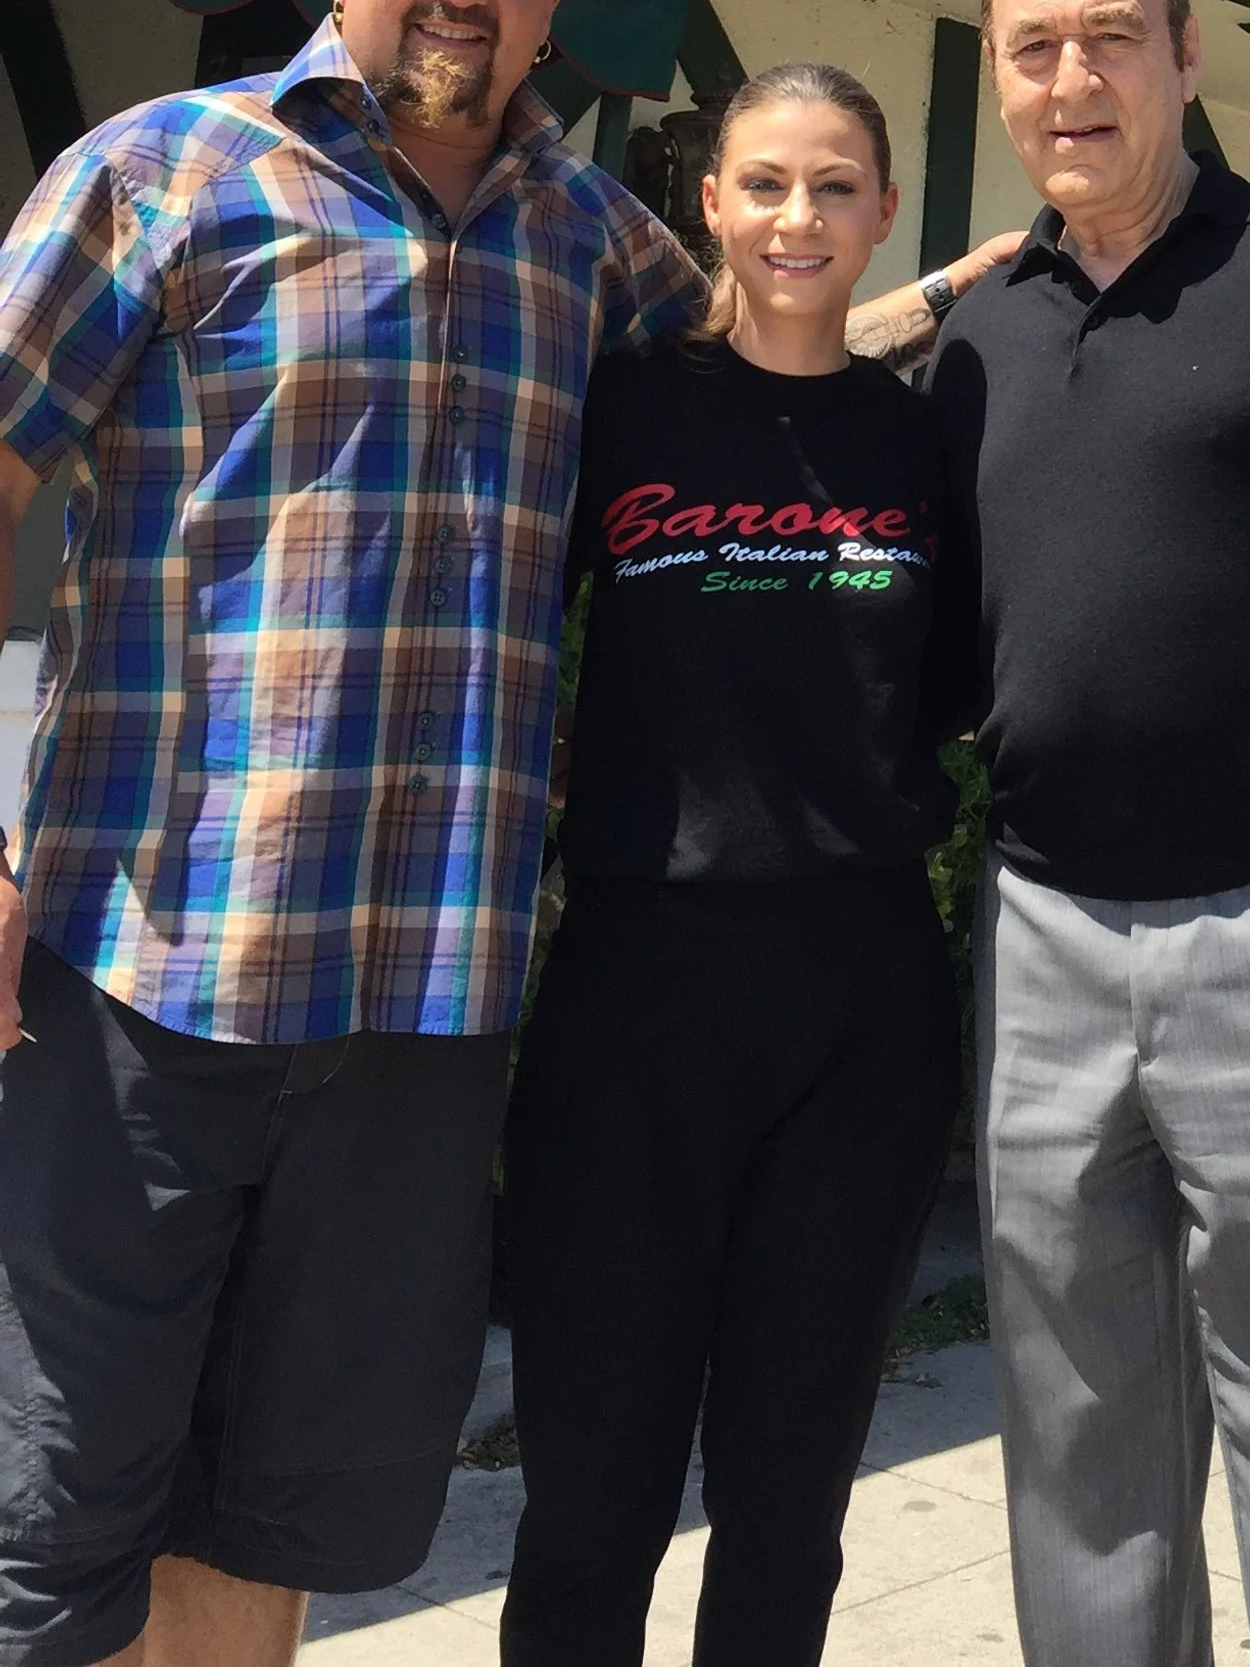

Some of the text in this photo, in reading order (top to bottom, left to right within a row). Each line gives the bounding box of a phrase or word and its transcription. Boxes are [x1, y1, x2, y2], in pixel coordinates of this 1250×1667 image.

[615, 549, 708, 584] Famous
[718, 542, 829, 562] Italian
[700, 570, 893, 592] Since 1945
